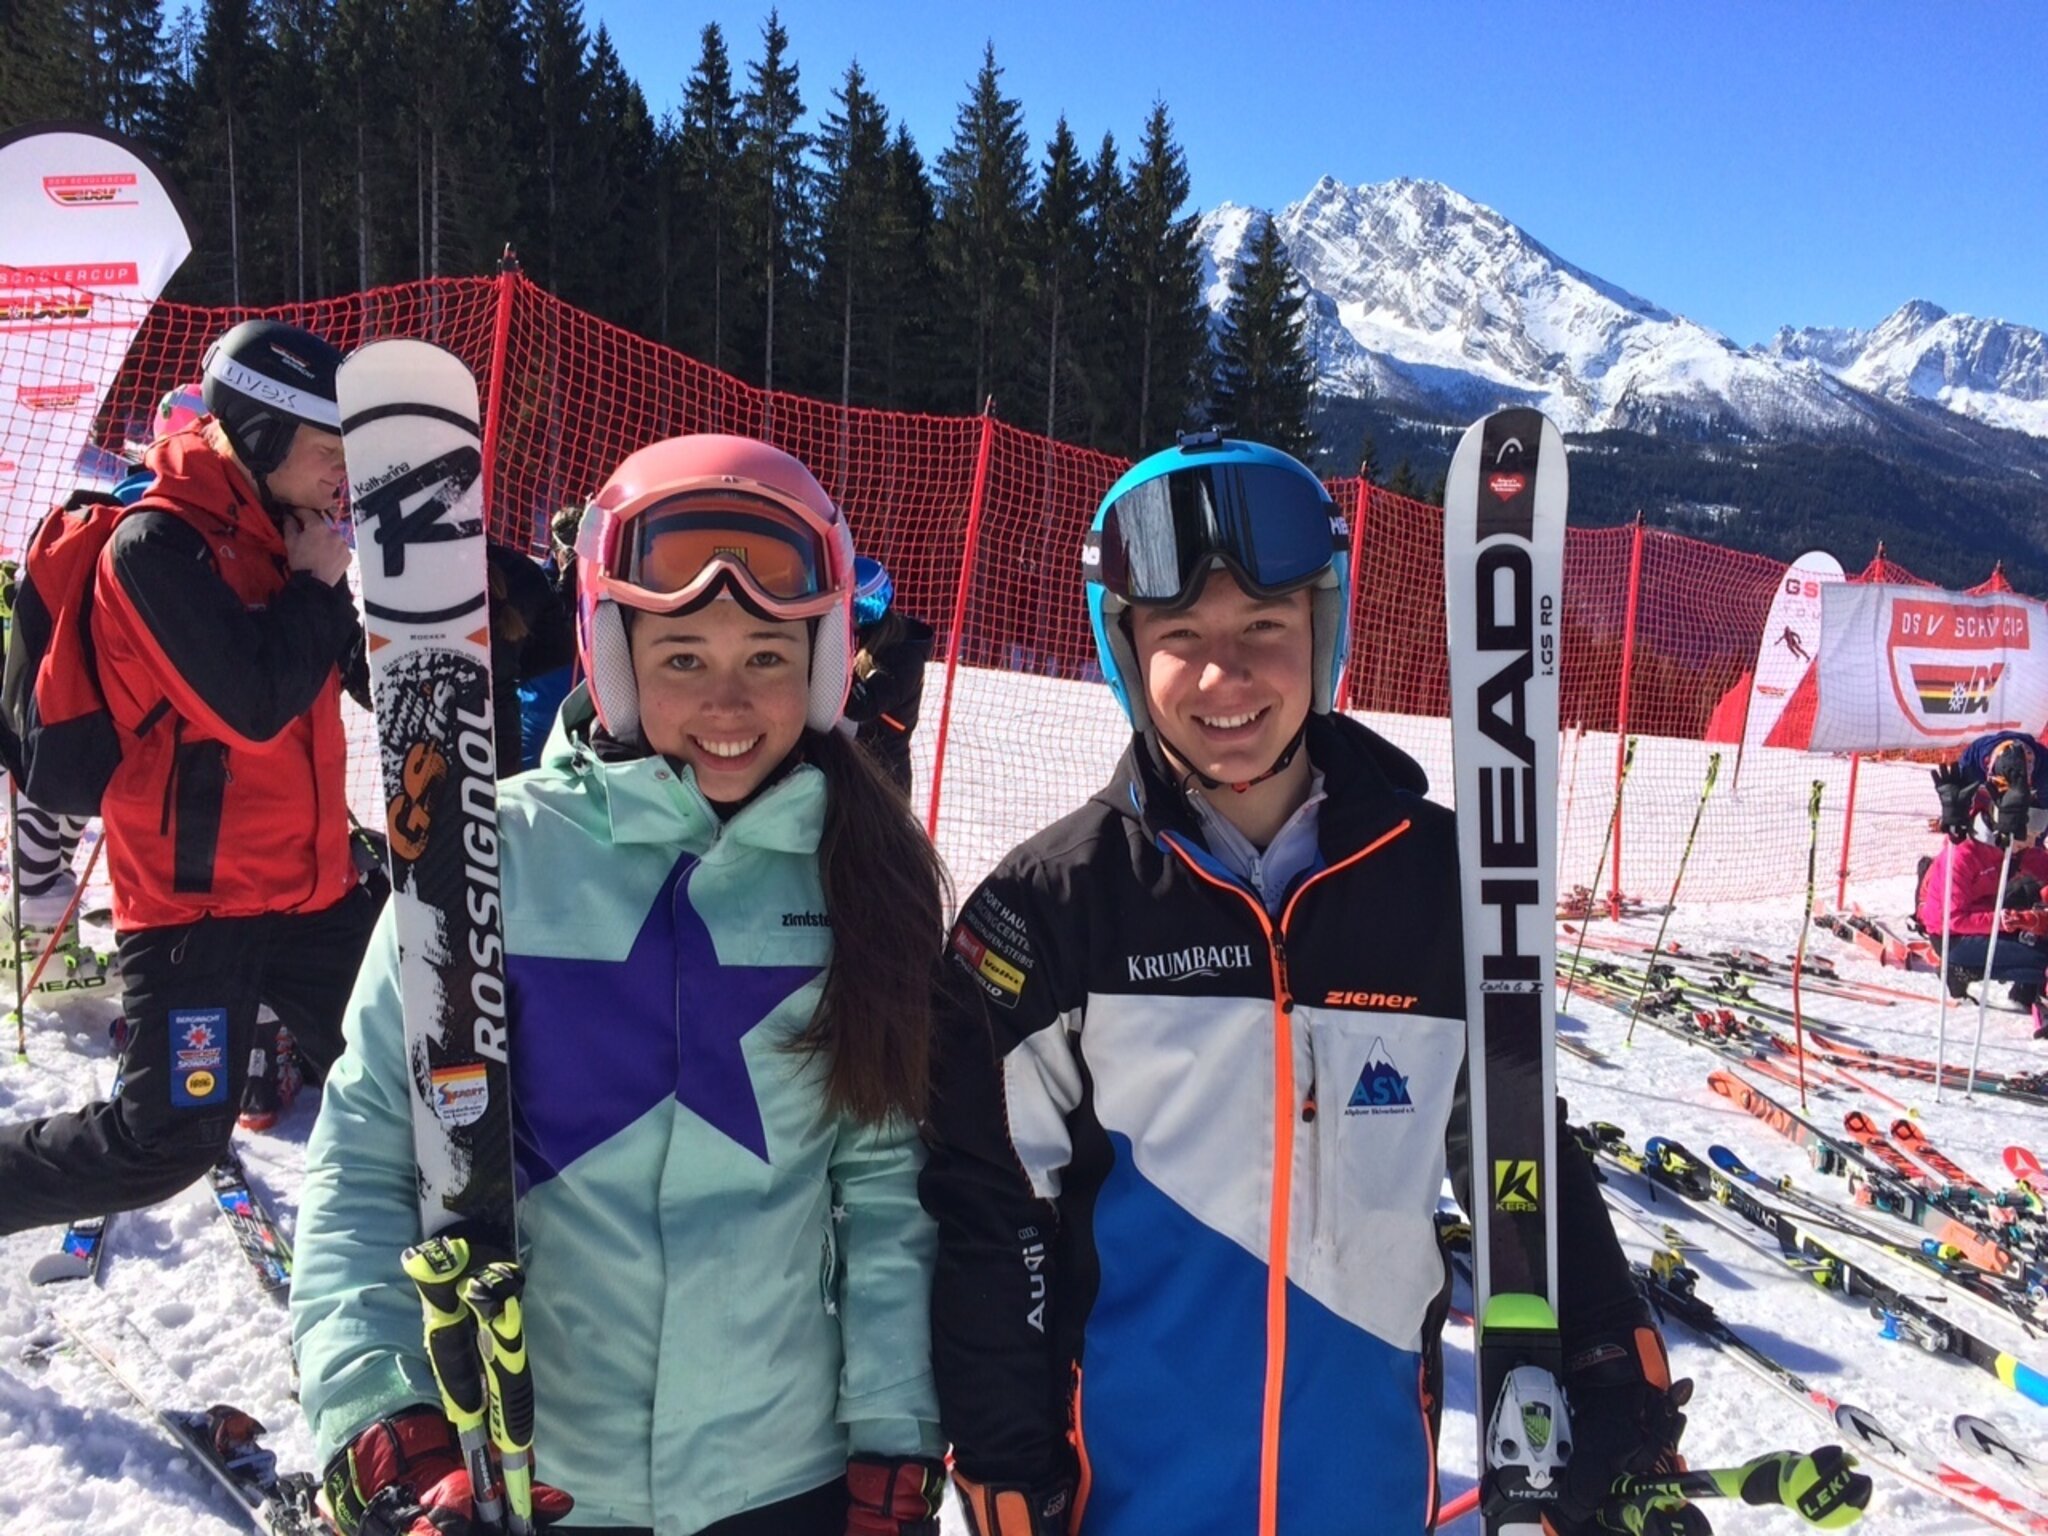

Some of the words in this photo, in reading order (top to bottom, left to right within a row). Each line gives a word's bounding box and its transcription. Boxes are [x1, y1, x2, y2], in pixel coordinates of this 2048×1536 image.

[223, 363, 297, 409] uvex
[353, 462, 412, 496] Katharina
[1540, 595, 1554, 626] RD
[1476, 543, 1541, 982] HEAD
[457, 698, 508, 1064] ROSSIGNOL
[1127, 945, 1252, 981] KRUMBACH
[1324, 991, 1418, 1008] ziener
[1350, 1076, 1409, 1105] ASV
[1495, 1202, 1538, 1212] KERS
[1022, 1243, 1046, 1334] Audi
[489, 1391, 502, 1440] LEKI
[1804, 1470, 1851, 1517] LEKI
